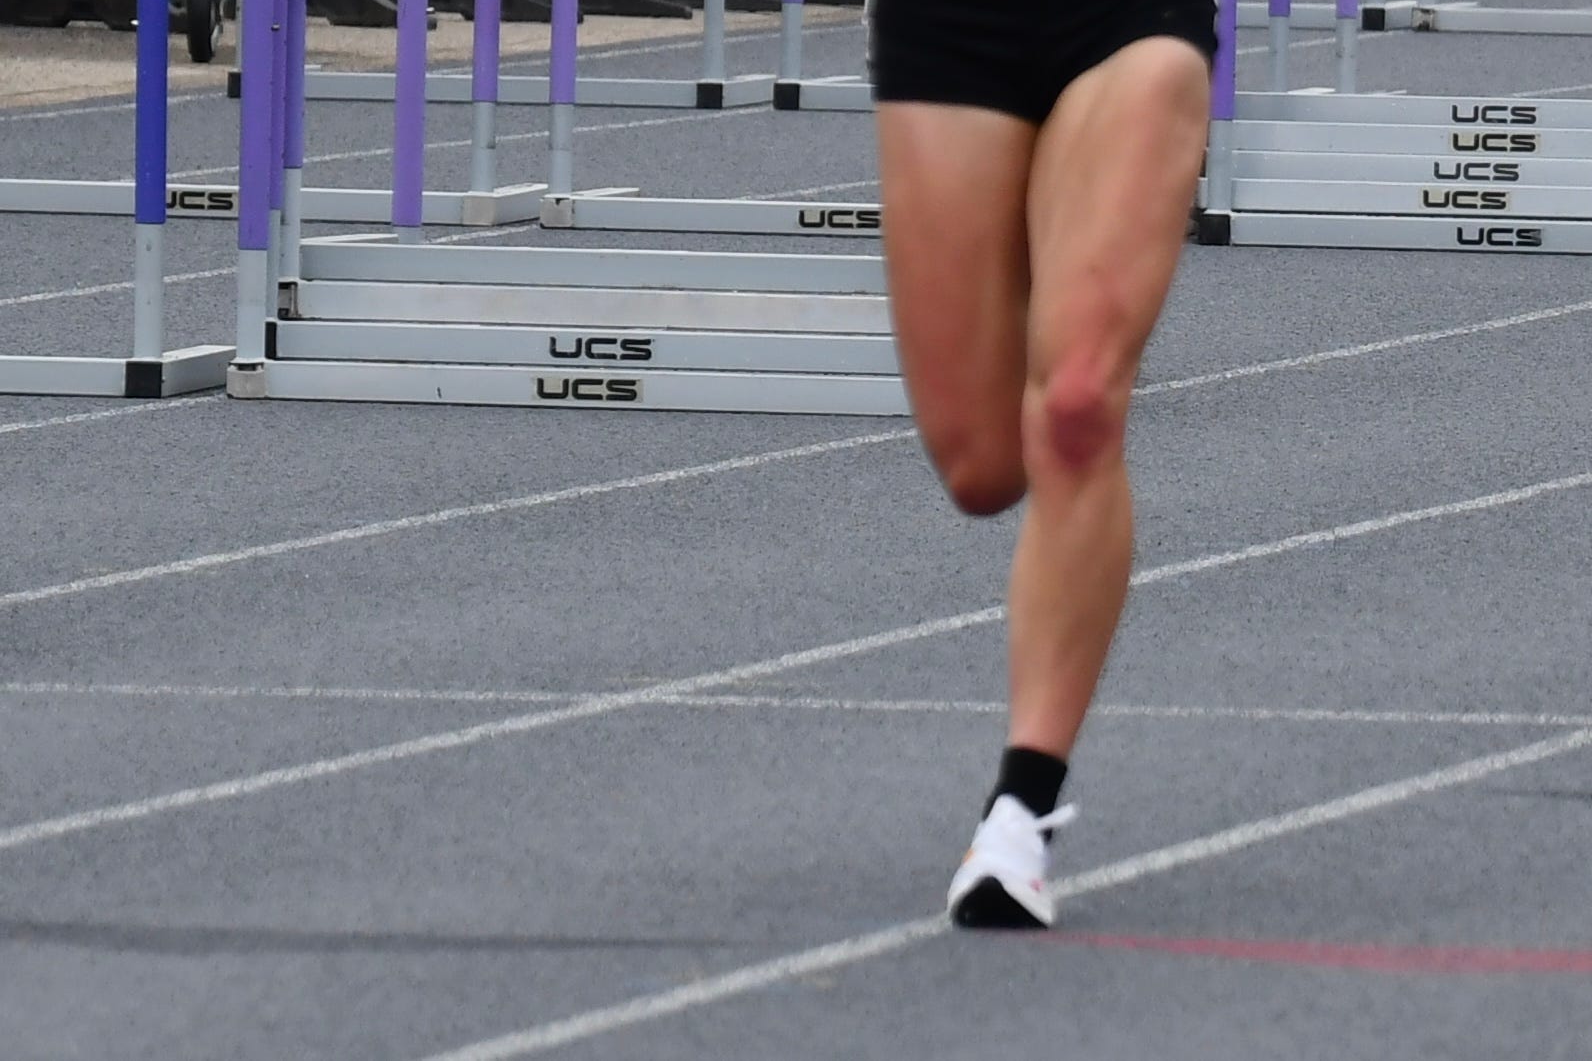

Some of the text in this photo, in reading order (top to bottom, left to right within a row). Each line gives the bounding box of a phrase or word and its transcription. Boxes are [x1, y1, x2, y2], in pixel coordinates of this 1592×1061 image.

[1452, 105, 1537, 125] UCS
[1453, 133, 1537, 152] UCS
[1434, 162, 1519, 182] UCS
[1423, 190, 1507, 210] UCS
[798, 210, 881, 229] UCS
[1457, 227, 1542, 247] UCS
[549, 336, 653, 361] UCS
[537, 378, 638, 402] UCS
